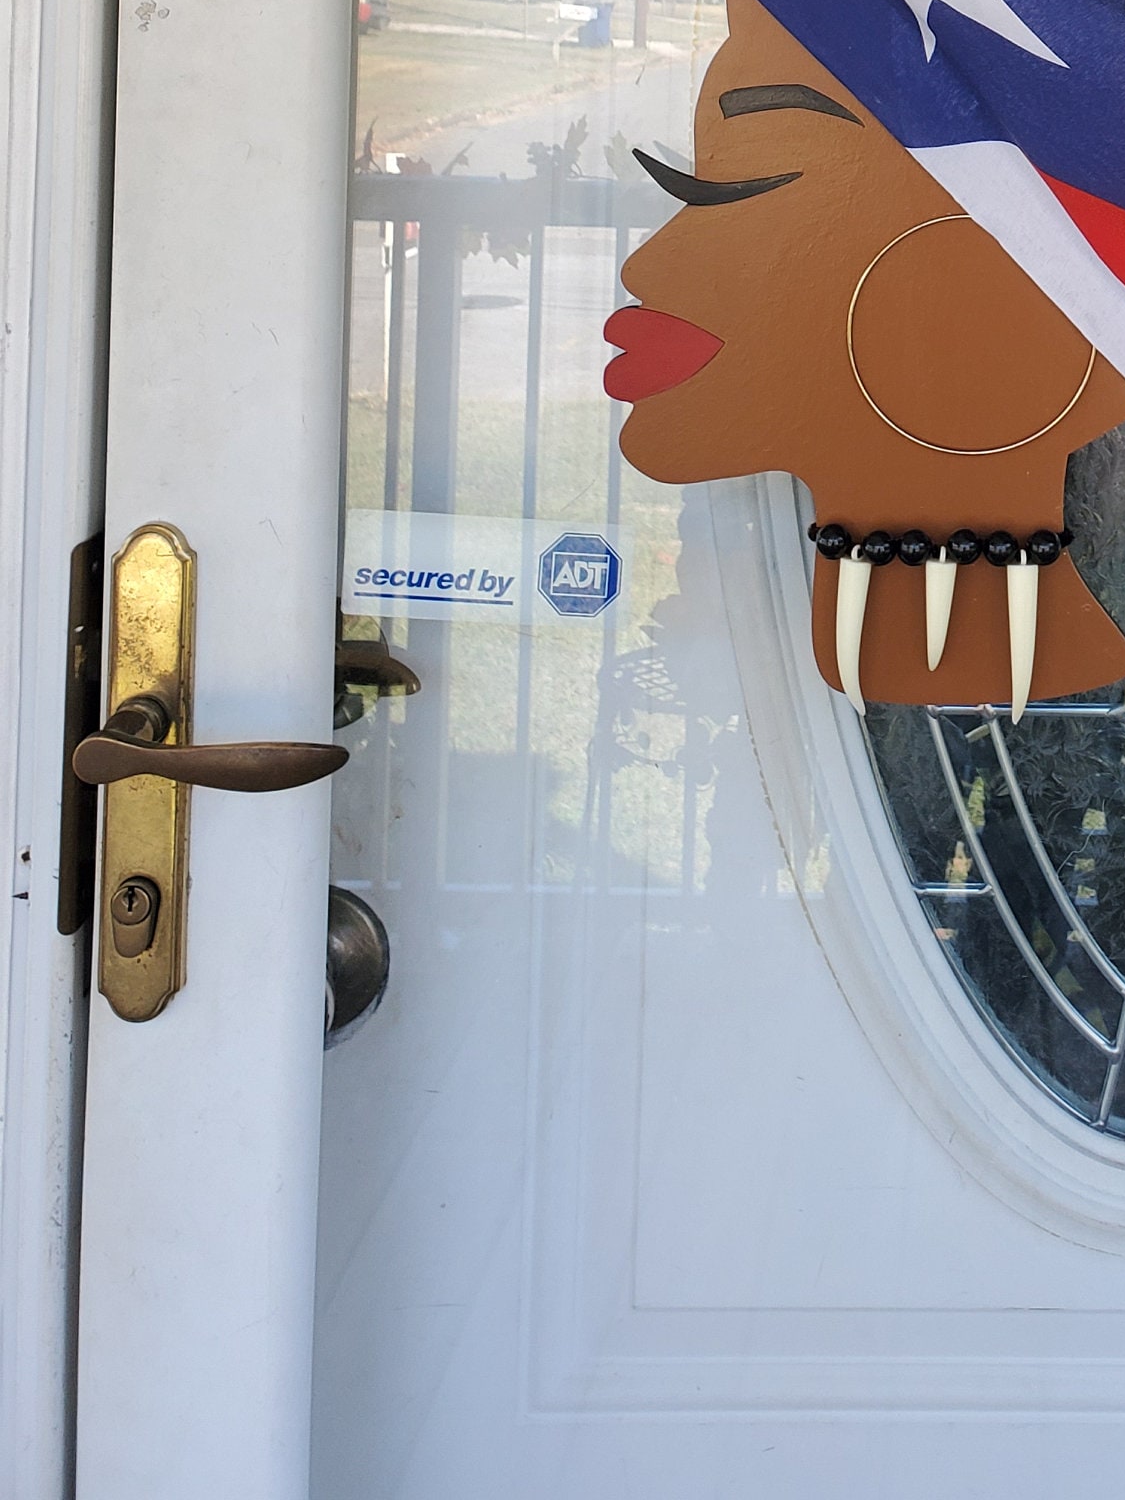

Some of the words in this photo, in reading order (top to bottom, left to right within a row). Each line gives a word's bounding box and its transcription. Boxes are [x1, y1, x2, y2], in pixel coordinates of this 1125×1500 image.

[355, 567, 475, 591] secured
[479, 569, 514, 597] by
[554, 560, 608, 590] ADT
